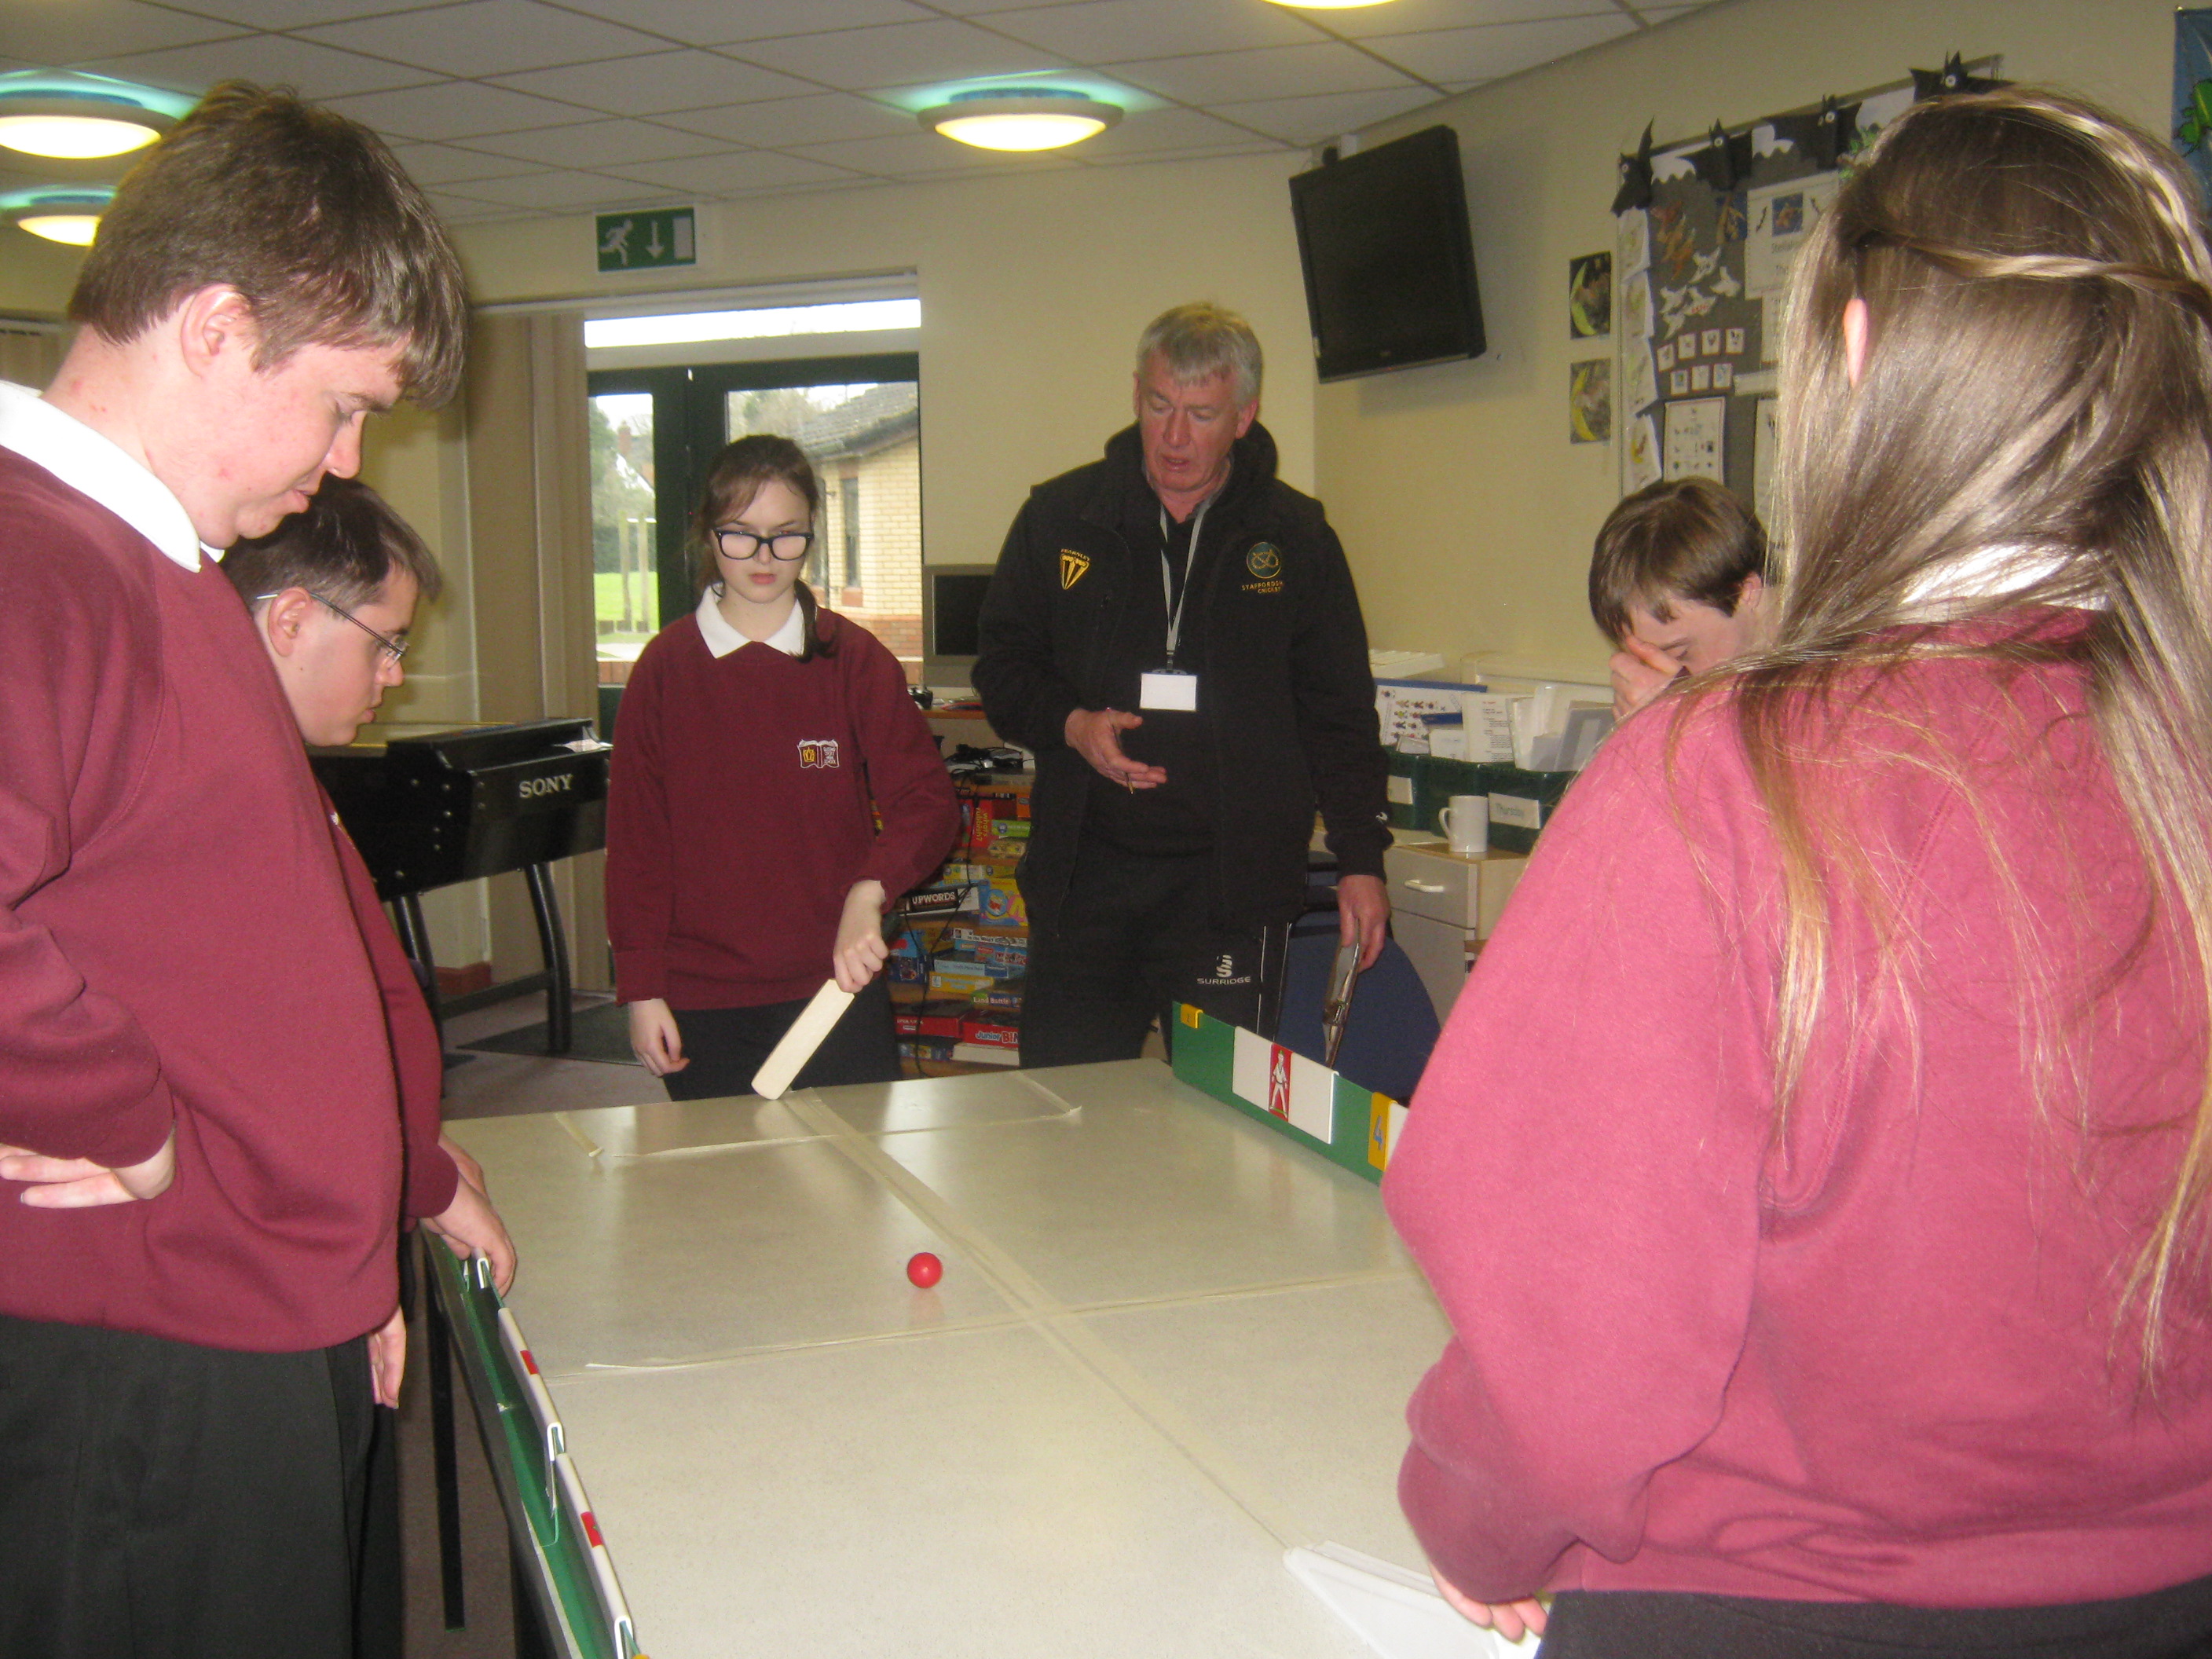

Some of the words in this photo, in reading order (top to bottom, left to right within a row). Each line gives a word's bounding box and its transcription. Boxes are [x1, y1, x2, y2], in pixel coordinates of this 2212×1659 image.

[518, 774, 573, 798] SONY
[911, 892, 956, 905] UPWORDS
[1196, 976, 1251, 985] SURRIDGE
[976, 1031, 1002, 1041] Junior
[1002, 1031, 1019, 1044] BIN
[1374, 1115, 1384, 1151] 4
